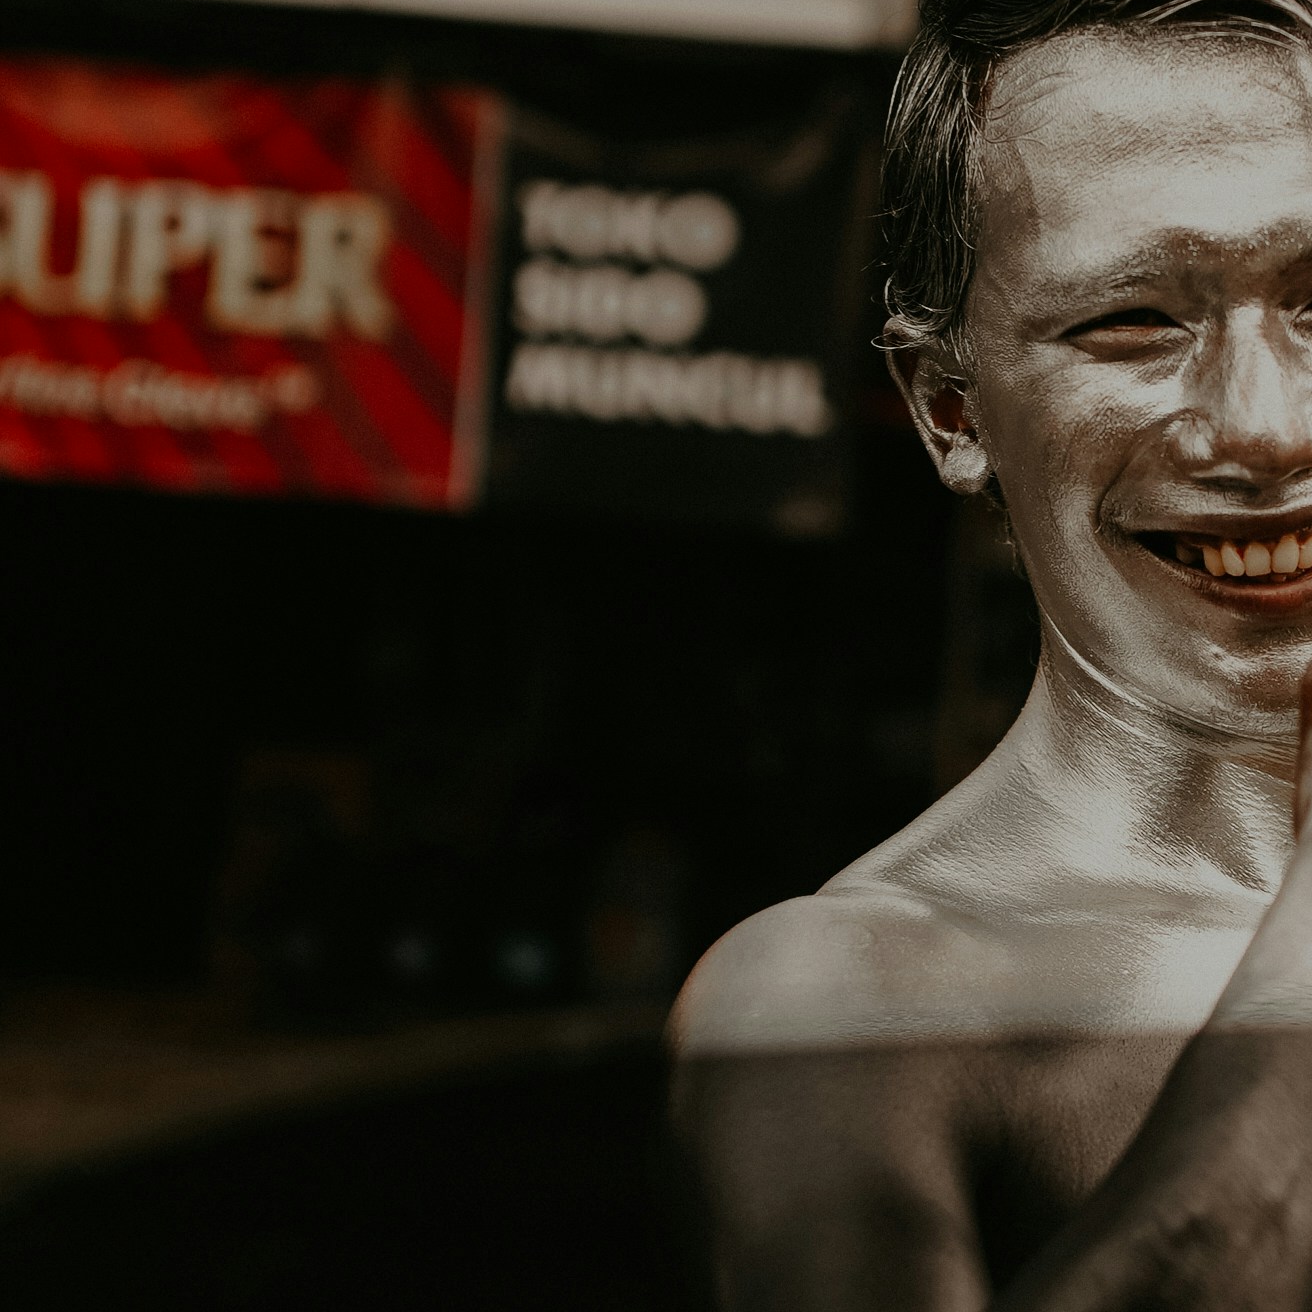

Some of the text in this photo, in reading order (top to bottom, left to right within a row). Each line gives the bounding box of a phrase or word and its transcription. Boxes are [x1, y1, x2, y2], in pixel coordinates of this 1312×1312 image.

[0, 168, 395, 343] UPER
[518, 179, 740, 269] TOKO
[514, 258, 707, 344] SIDO
[506, 343, 834, 437] MUNCUL
